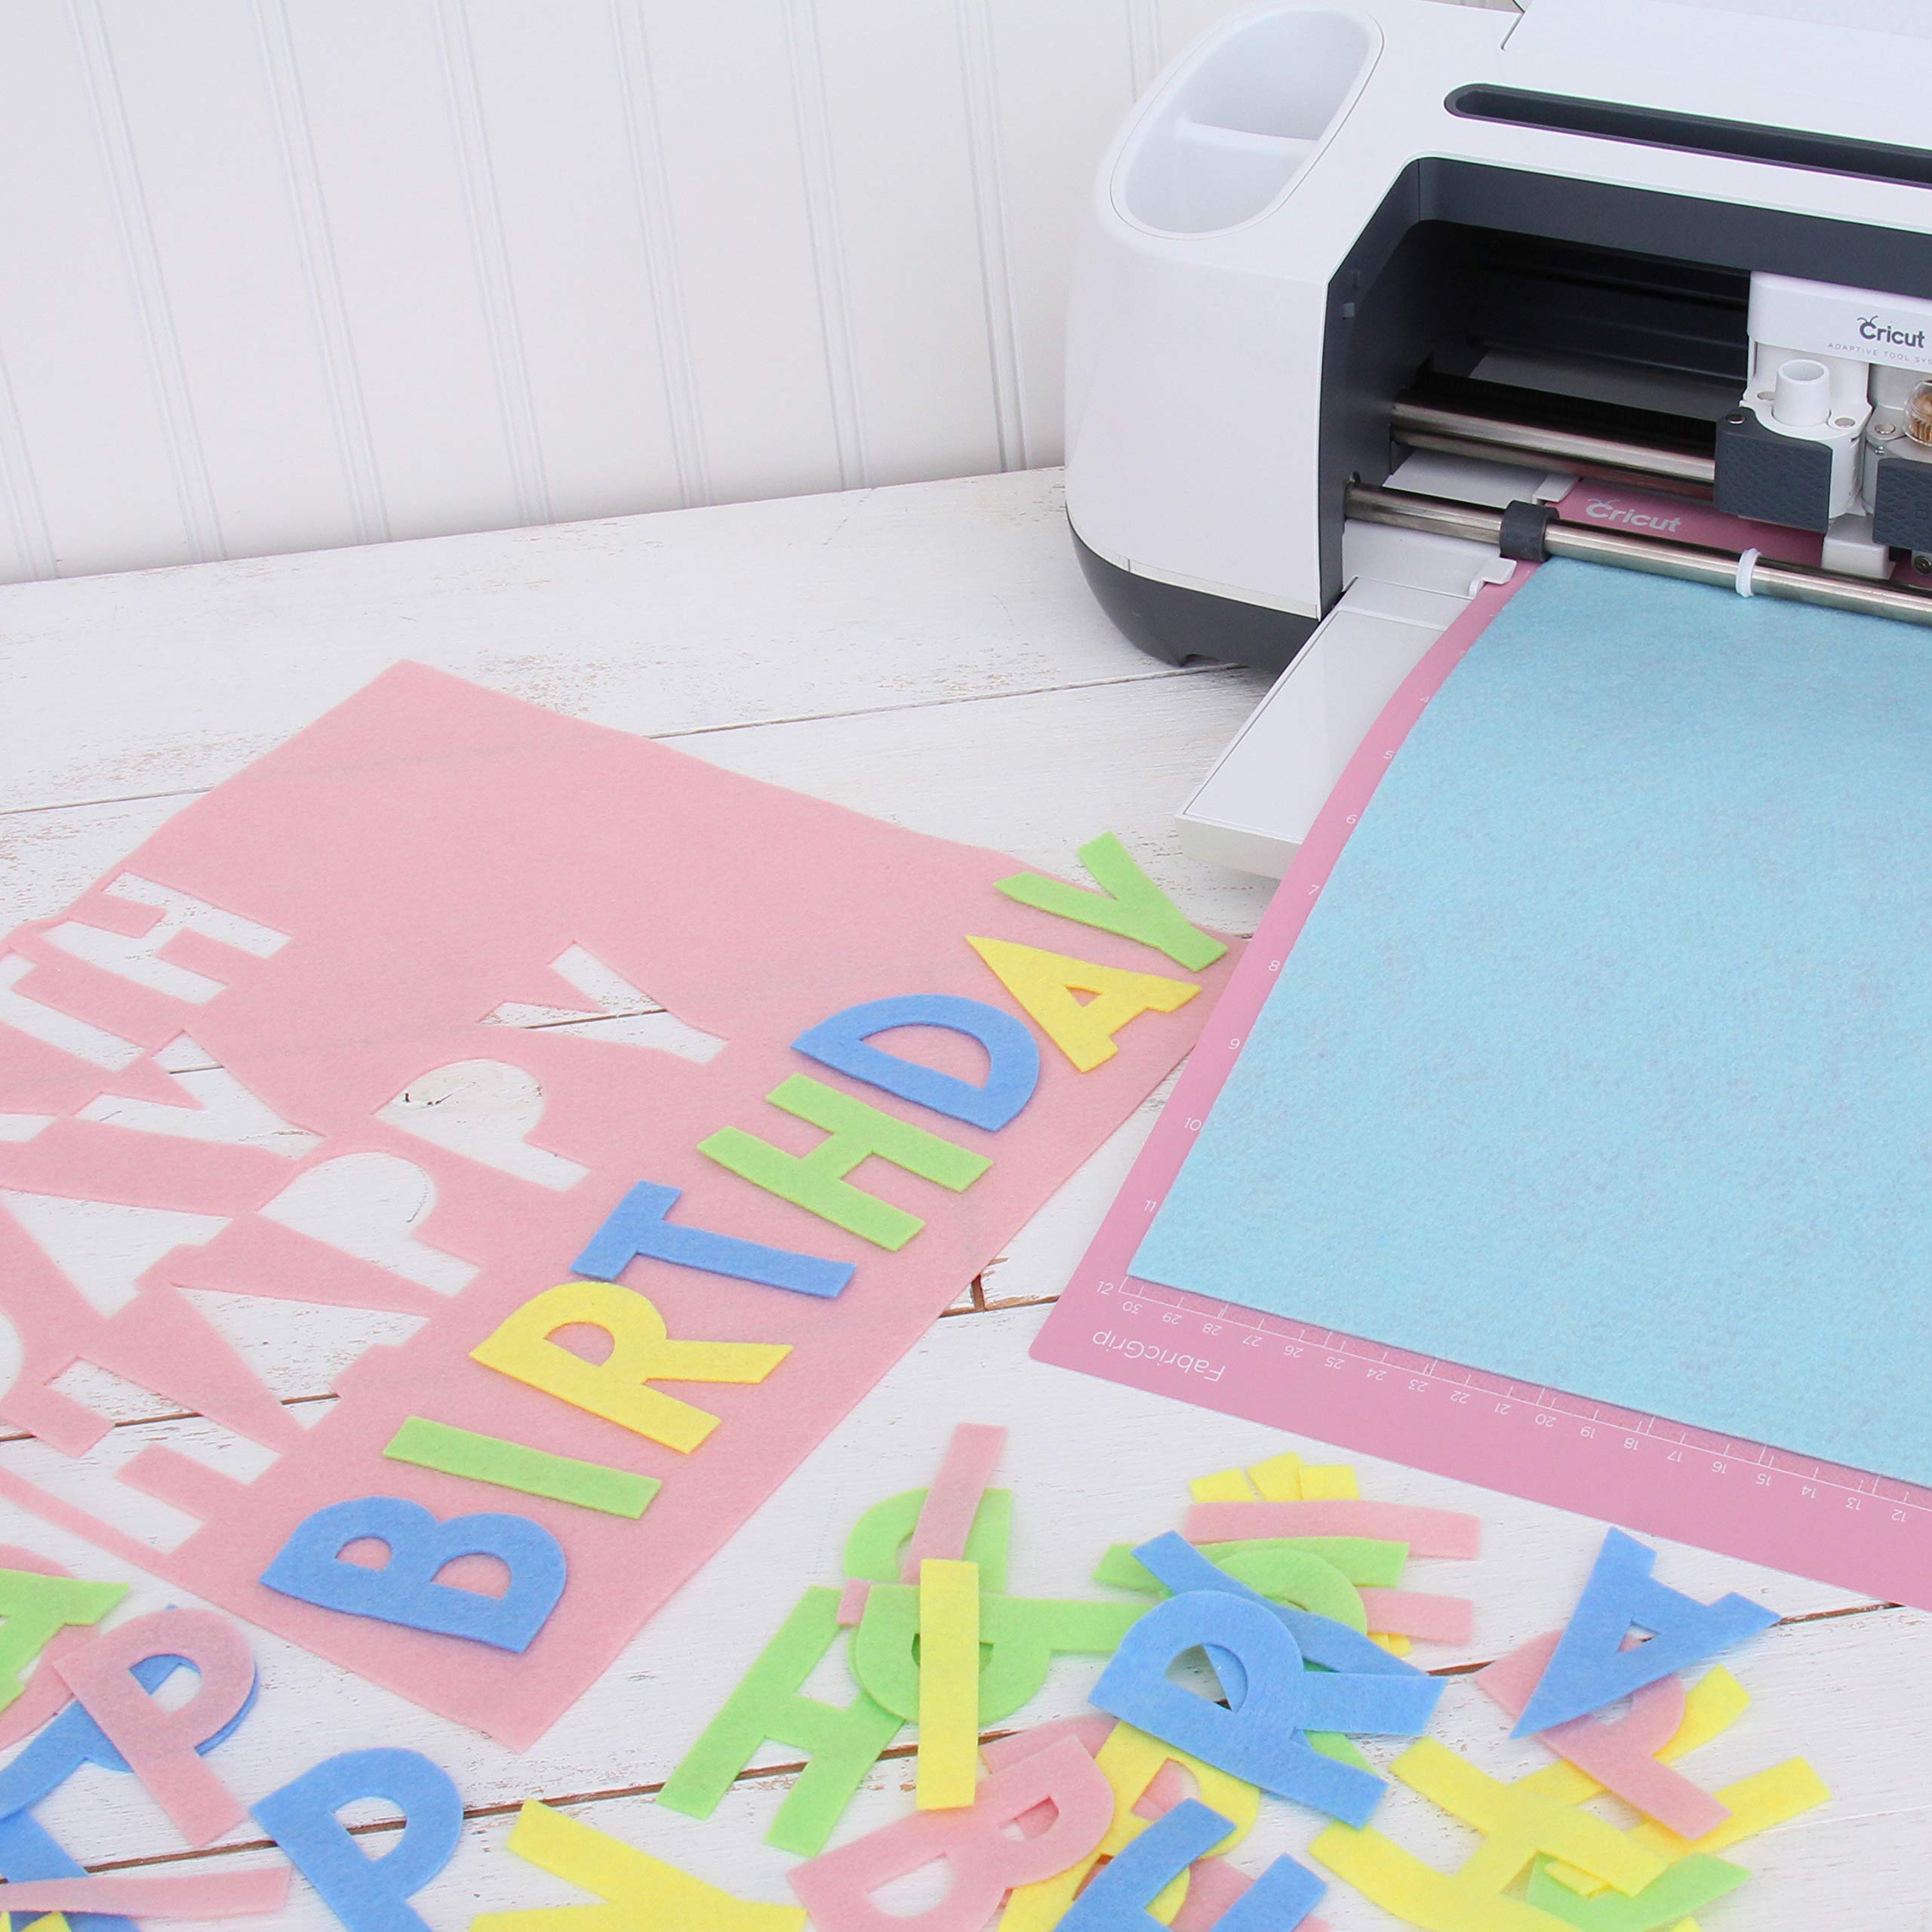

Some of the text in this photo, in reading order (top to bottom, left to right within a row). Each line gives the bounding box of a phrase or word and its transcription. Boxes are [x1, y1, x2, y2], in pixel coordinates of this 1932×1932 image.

[1857, 315, 1925, 348] Cricut
[1828, 343, 1878, 356] ADAPTIVE
[1884, 351, 1909, 361] TOOL
[1586, 498, 1681, 532] Cricut
[1383, 749, 1394, 759] 5
[1346, 814, 1356, 825] 6
[1308, 884, 1319, 896] 7
[1268, 961, 1279, 971] 8
[1229, 1038, 1240, 1050] 9
[1184, 1117, 1202, 1131] 10
[1144, 1200, 1157, 1213] 11
[260, 834, 1229, 1653] BIRTHDAY
[1097, 1281, 1113, 1295] 12
[1123, 1300, 1143, 1314] 30
[1163, 1312, 1182, 1324] 29
[1202, 1323, 1222, 1335] 28
[1242, 1334, 1263, 1346] 27
[1091, 1330, 1226, 1383] FabricGrip
[1284, 1346, 1303, 1358] 26
[1324, 1357, 1345, 1369] 25
[1367, 1367, 1386, 1380] 24
[1408, 1379, 1429, 1392] 23
[1451, 1390, 1470, 1403] 22
[1495, 1403, 1511, 1414] 21
[1536, 1414, 1556, 1427] 20
[1581, 1426, 1595, 1438] 19
[1624, 1438, 1638, 1450] 18
[1667, 1451, 1682, 1462] 17
[1712, 1461, 1727, 1473] 16
[1757, 1473, 1770, 1485] 15
[1801, 1485, 1816, 1498] 14
[1846, 1497, 1860, 1510] 13
[1892, 1509, 1906, 1521] 12
